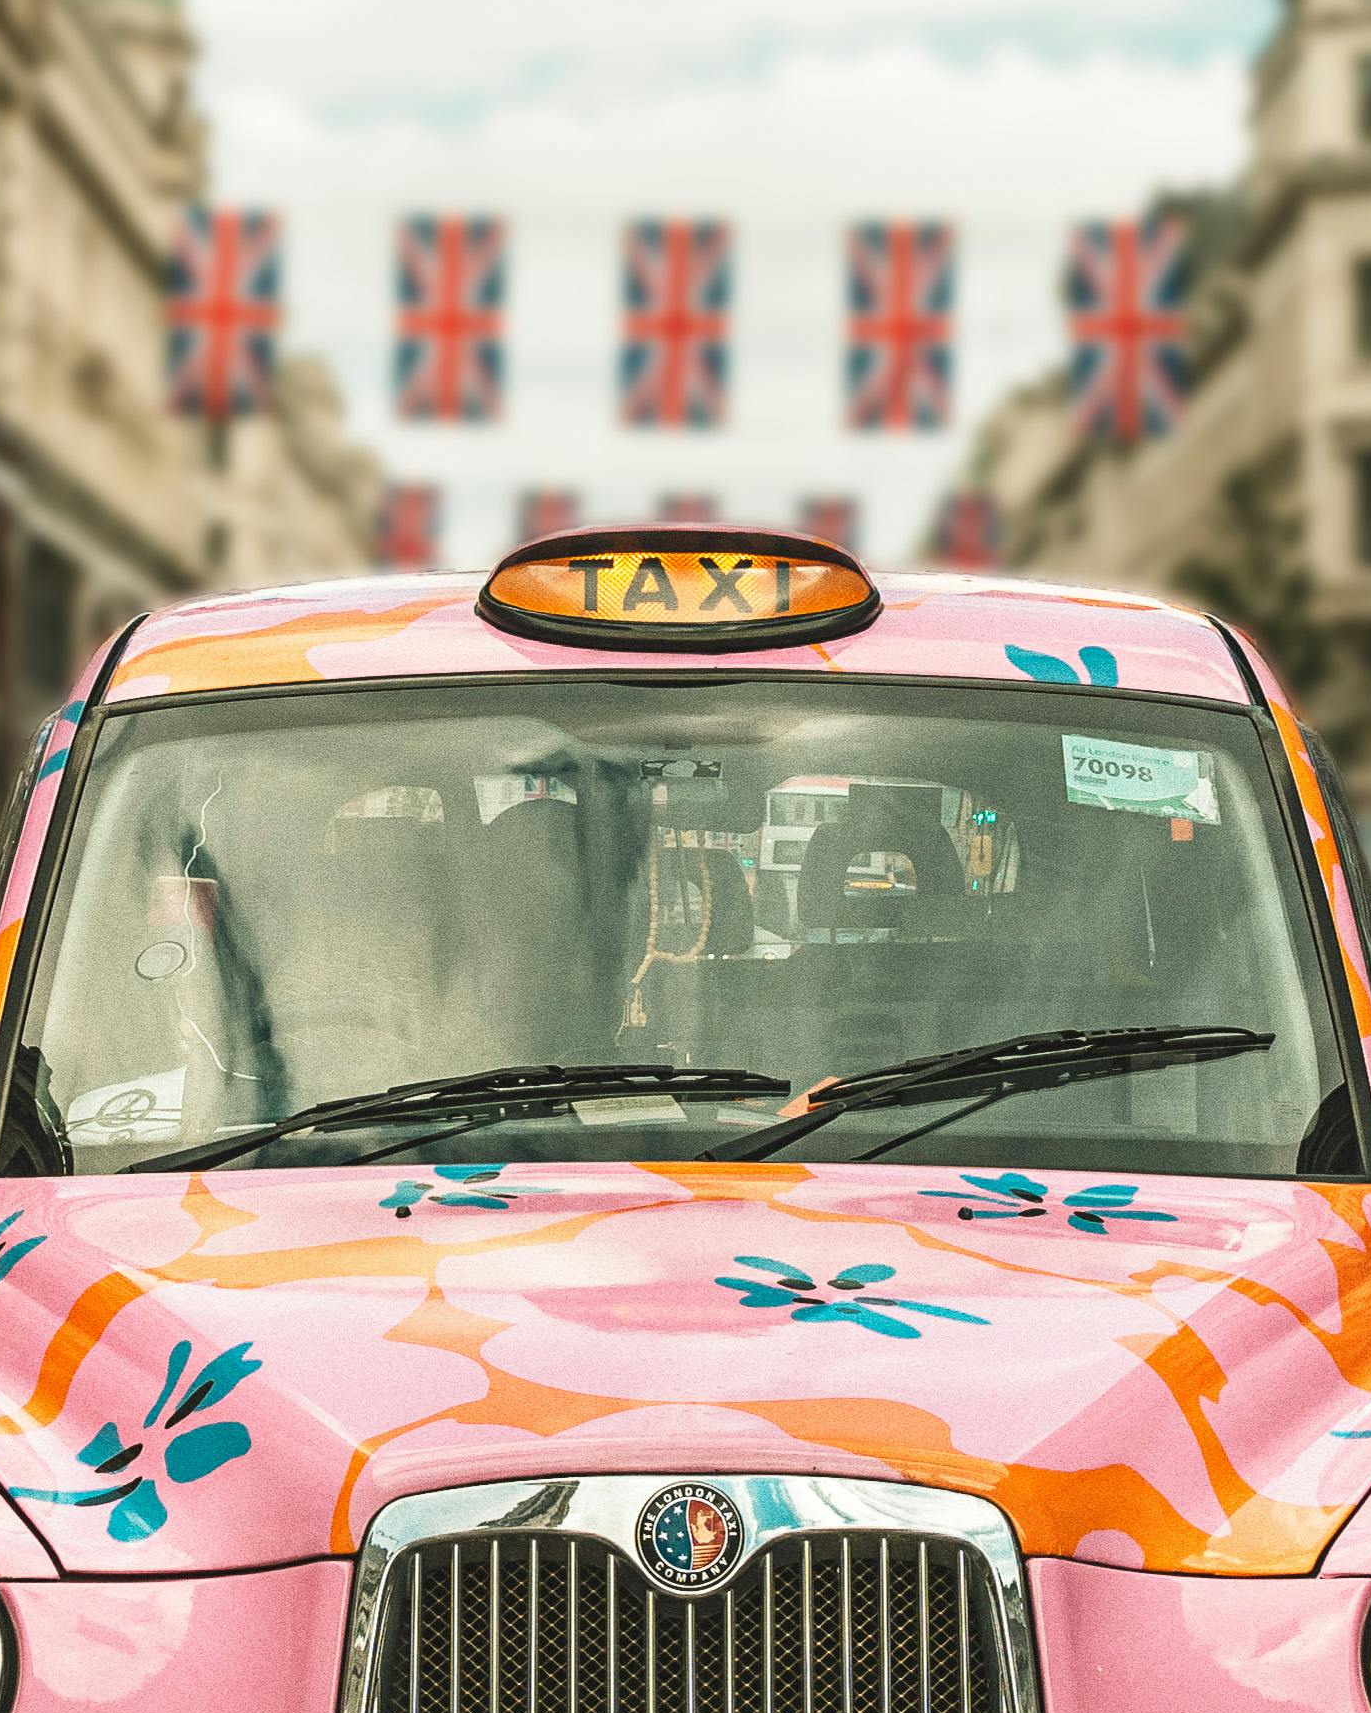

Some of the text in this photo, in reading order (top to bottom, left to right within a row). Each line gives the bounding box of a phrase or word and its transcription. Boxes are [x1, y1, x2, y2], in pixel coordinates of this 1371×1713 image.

[568, 557, 790, 613] TAXI
[1072, 756, 1153, 782] 70098
[643, 1487, 738, 1540] THE LONDON TAXI
[655, 1556, 728, 1583] COMPANY
